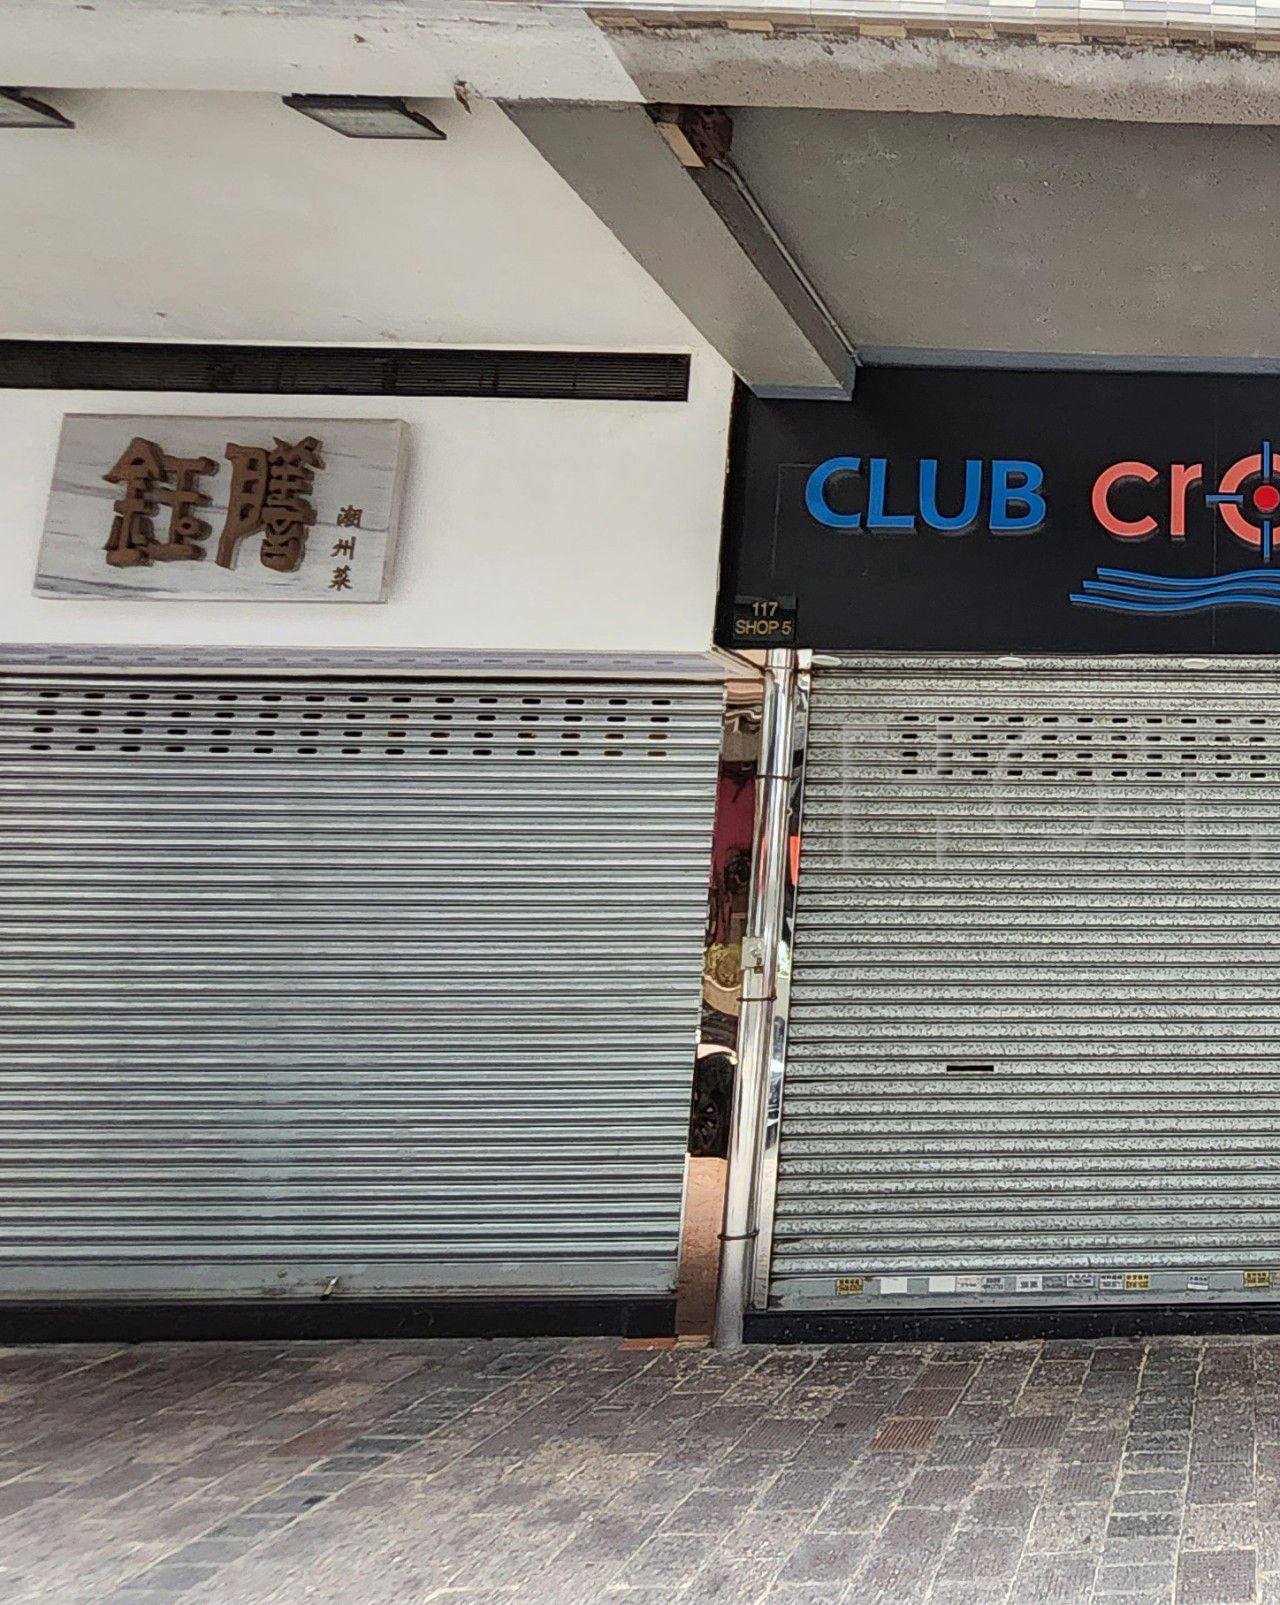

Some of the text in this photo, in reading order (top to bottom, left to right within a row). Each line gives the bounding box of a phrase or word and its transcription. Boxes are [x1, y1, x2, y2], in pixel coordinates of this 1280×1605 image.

[804, 456, 1047, 530] CLUB
[327, 503, 363, 592] 潮州菜
[735, 619, 792, 635] SHOP 5
[752, 601, 779, 617] 117
